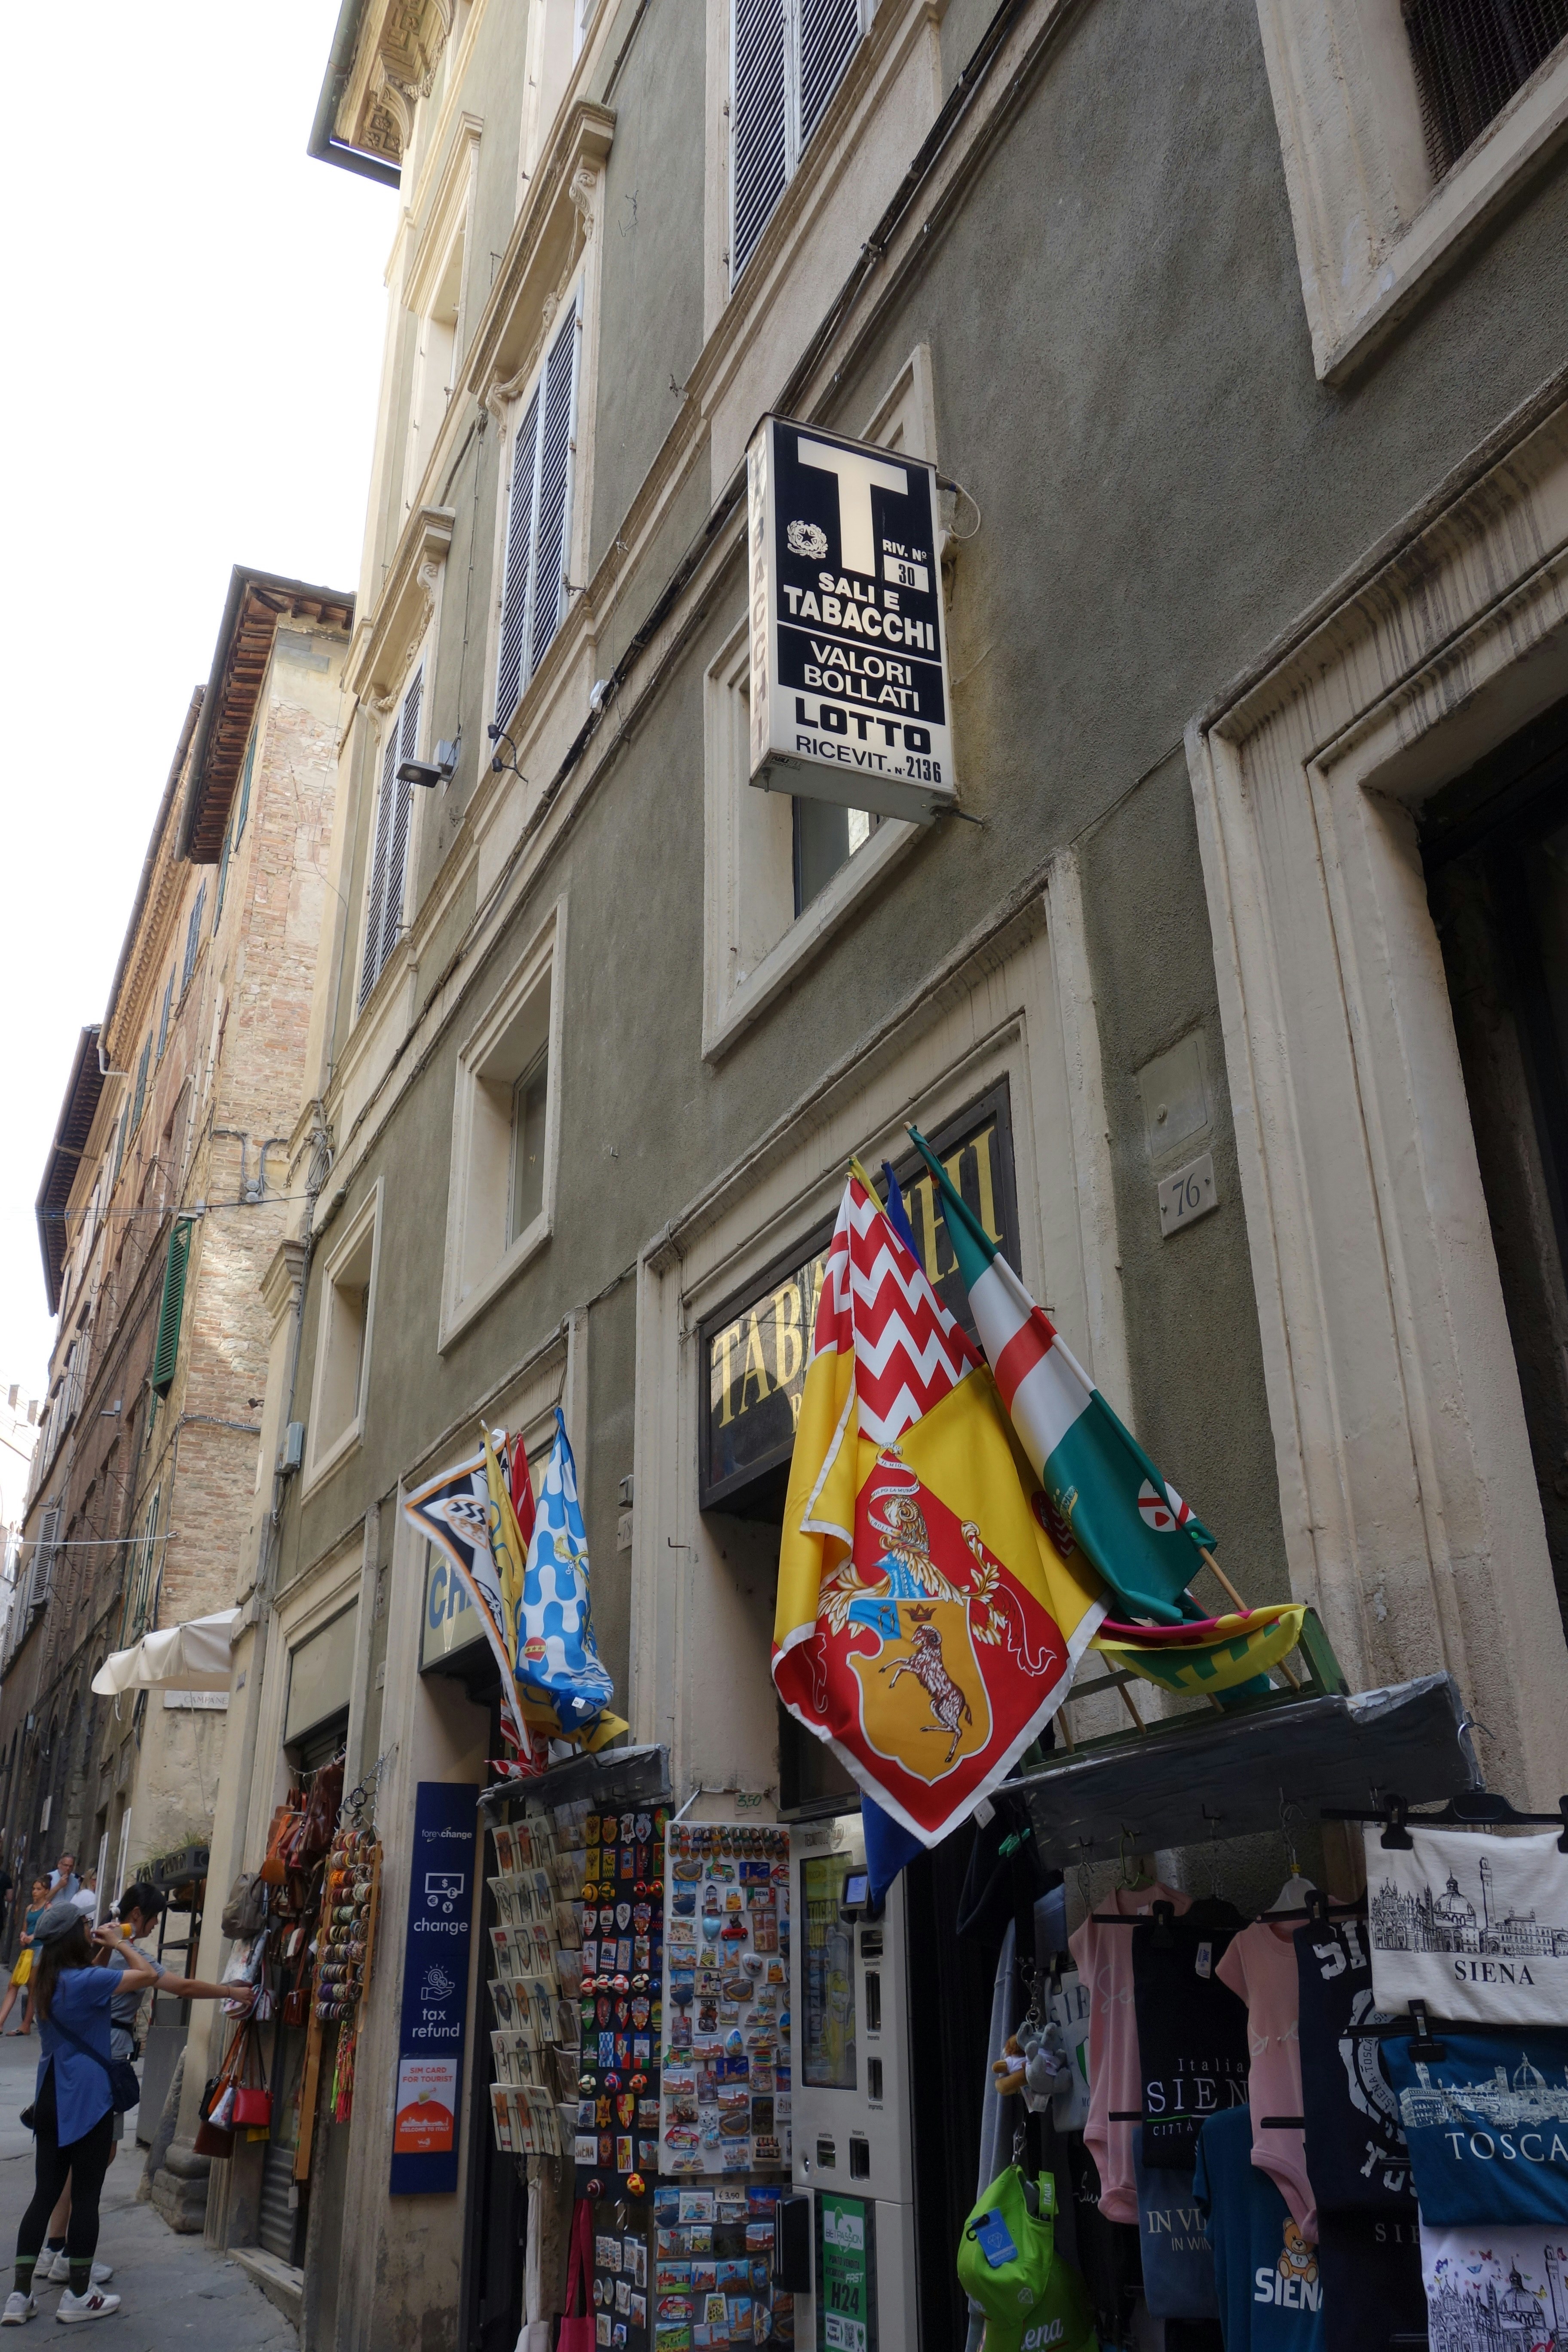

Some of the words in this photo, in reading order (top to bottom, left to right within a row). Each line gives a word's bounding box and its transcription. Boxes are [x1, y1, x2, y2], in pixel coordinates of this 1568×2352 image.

[797, 436, 909, 577] T
[882, 539, 908, 557] RIV.
[898, 564, 915, 587] 30
[818, 572, 875, 604] SALI
[884, 589, 900, 611] E
[783, 584, 934, 651] TABACCHI
[810, 640, 912, 686] VALORI
[804, 663, 920, 712] BOLLATI
[795, 696, 931, 755] LOTTO
[796, 734, 891, 773] RICEVIT.
[906, 755, 942, 784] 2136
[1172, 1172, 1200, 1217] 76
[881, 1442, 900, 1450] SOTTO
[873, 1487, 888, 1496] OLPO
[870, 1519, 893, 1533] CROLLA
[429, 1565, 472, 1629] CH
[737, 1795, 762, 1808] 3,50
[413, 1917, 469, 1936] change
[1455, 1960, 1535, 1985] SIENA
[422, 2008, 446, 2021] tax
[412, 2022, 460, 2038] refund
[1178, 2058, 1245, 2072] Italia
[725, 2191, 740, 2200] 3,50
[1043, 2183, 1051, 2205] ITALIA
[1147, 2210, 1172, 2233] IN
[1171, 2237, 1184, 2252] IN
[829, 2254, 843, 2266] PUNTO
[843, 2257, 860, 2270] VENDITA
[845, 2271, 864, 2283] FAST
[831, 2281, 859, 2315] H24
[1254, 2266, 1323, 2312] SIEN
[1020, 2318, 1064, 2350] ena
